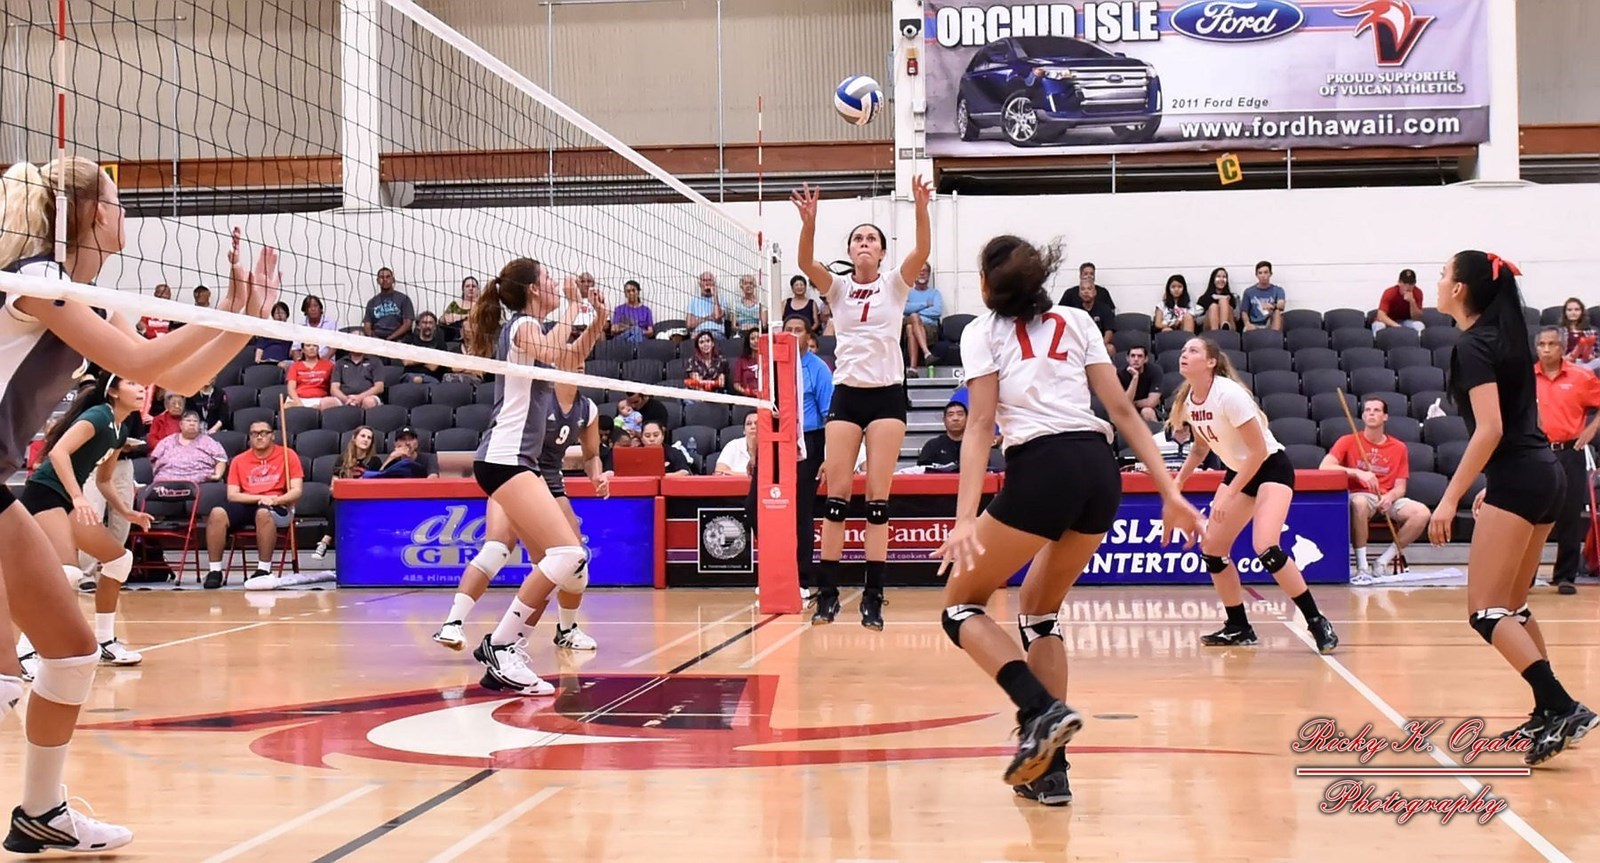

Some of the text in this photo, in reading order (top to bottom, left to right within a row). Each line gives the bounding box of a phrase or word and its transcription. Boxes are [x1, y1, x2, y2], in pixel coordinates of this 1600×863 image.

[936, 1, 1160, 47] ORCHID ISLE
[1195, 1, 1278, 34] Ford
[1326, 70, 1457, 84] PROUD SUPPORTER
[1319, 82, 1465, 96] OF VULCAN ATHLETICS
[1172, 97, 1270, 109] 2011 Ford Edge
[1180, 114, 1461, 140] www.fordhawaii.com
[1220, 158, 1238, 182] C
[858, 301, 870, 322] 1
[1013, 313, 1068, 361] 12
[556, 425, 570, 444] 9
[1198, 425, 1220, 443] 14
[426, 573, 460, 582] Hinan
